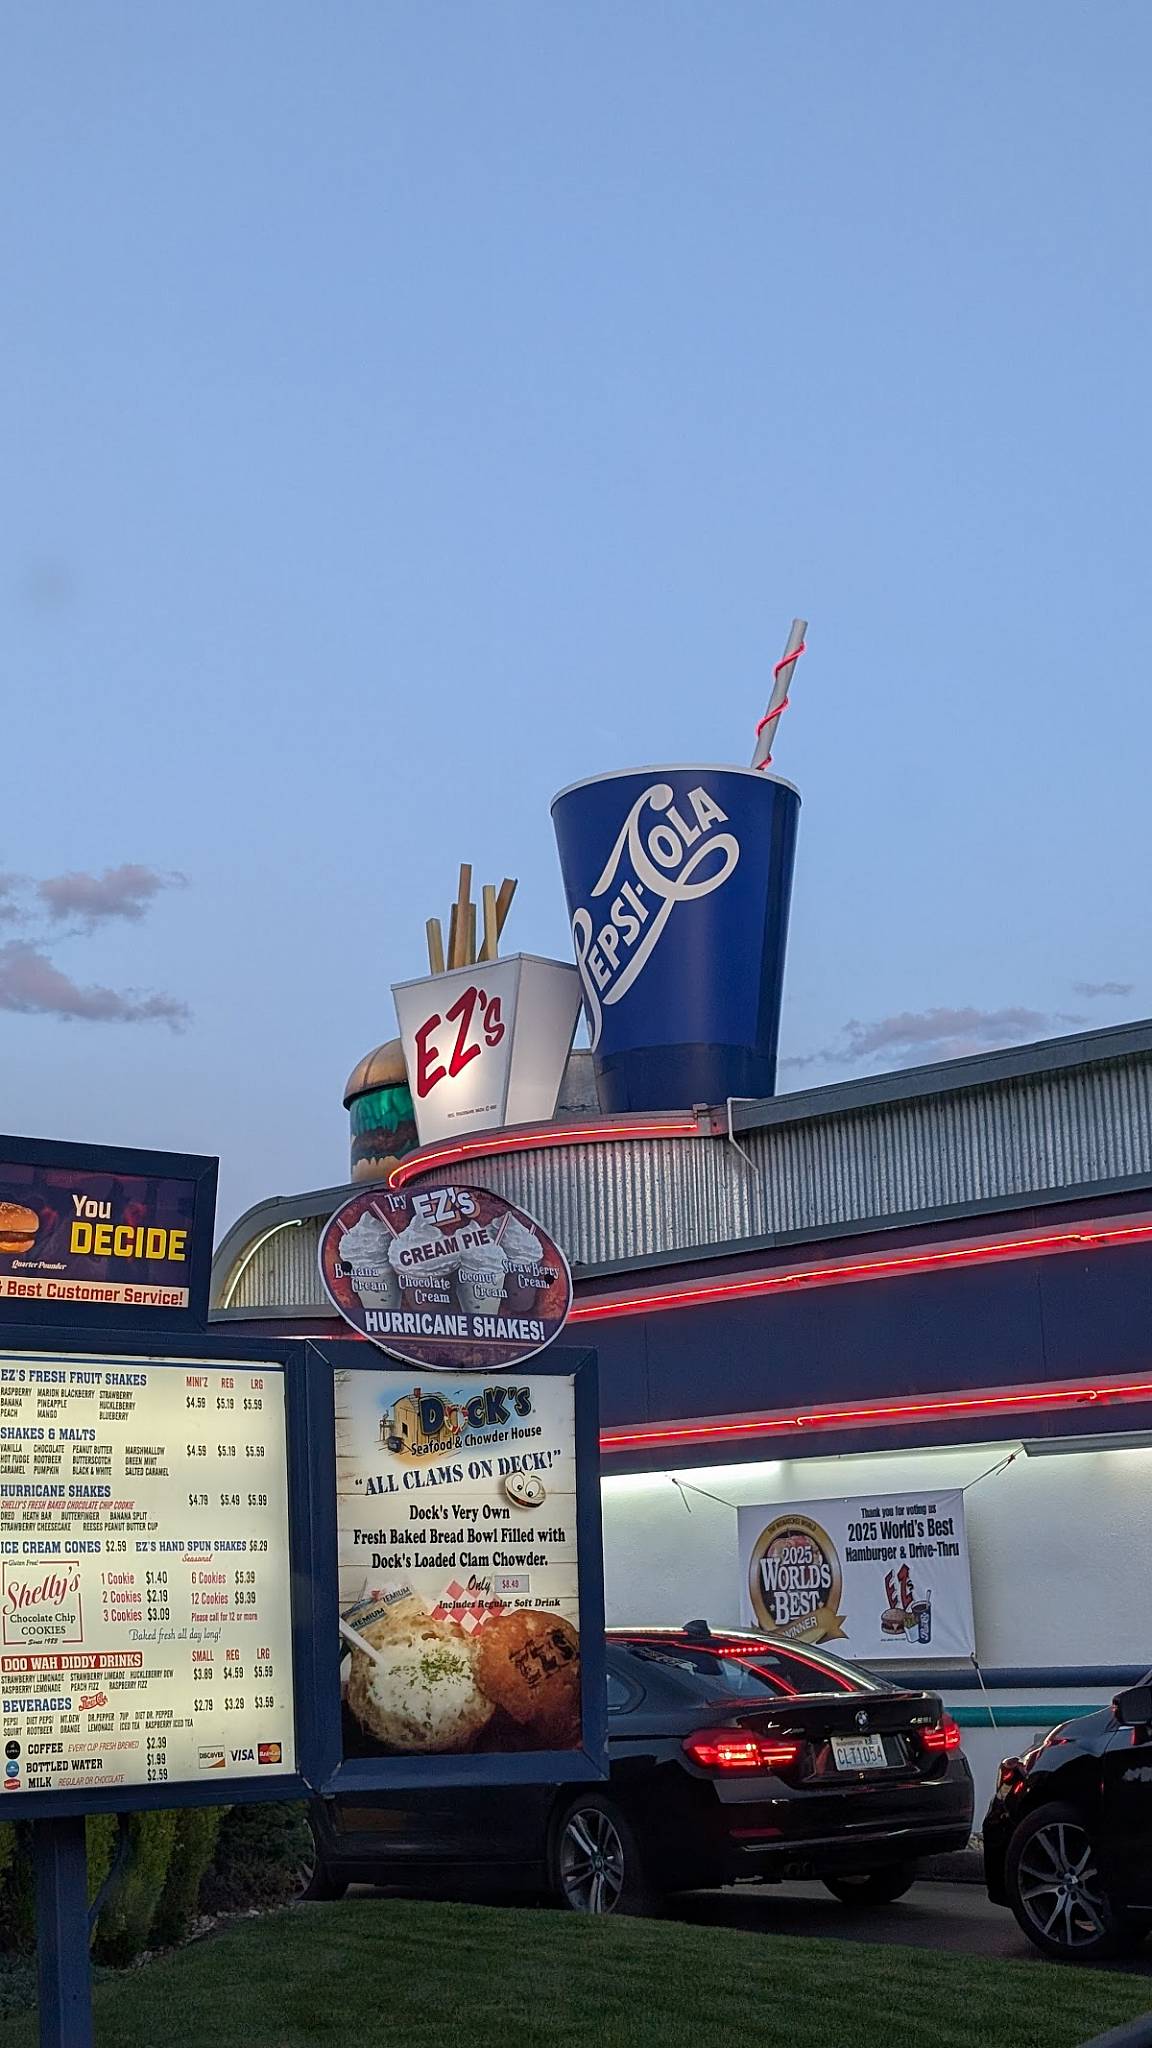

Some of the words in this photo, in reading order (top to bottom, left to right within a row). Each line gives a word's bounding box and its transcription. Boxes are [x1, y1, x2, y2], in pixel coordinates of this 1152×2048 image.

[72, 1194, 111, 1219] You
[384, 1193, 407, 1212] Try
[70, 1221, 187, 1260] DECIDE
[399, 1237, 460, 1266] CREAM
[462, 1229, 491, 1250] PIE
[12, 1259, 38, 1269] Quarter
[38, 1261, 67, 1270] Pounder
[334, 1263, 379, 1279] Bnana
[398, 1274, 450, 1290] Chocolate
[458, 1269, 497, 1285] Coconut
[7, 1281, 42, 1297] Best
[46, 1283, 120, 1301] Customer
[124, 1288, 183, 1305] Service!
[351, 1279, 388, 1293] Cream
[473, 1284, 508, 1299] Cream
[415, 1290, 450, 1305] Cream
[364, 1311, 468, 1336] HURRICANE
[473, 1317, 545, 1341] SHAKES!
[0, 1369, 26, 1381] EZ'S
[29, 1370, 66, 1383] FRESH
[69, 1371, 102, 1384] FRUIT
[105, 1372, 147, 1386] SHAKES
[221, 1377, 234, 1389] REG
[251, 1379, 263, 1390] LRG
[37, 1399, 68, 1408] PINEAPPLE
[99, 1401, 136, 1410] HUCKLEBERRY
[37, 1409, 58, 1418] MANGO
[0, 1427, 44, 1440] SHAKES
[60, 1428, 96, 1441] MALTS
[411, 1439, 452, 1456] Seafood
[454, 1436, 463, 1449] &
[464, 1429, 509, 1447] Chowder
[511, 1425, 542, 1440] House
[403, 1464, 464, 1490] CLAMS
[468, 1458, 495, 1480] ON
[0, 1484, 65, 1497] HURRICANE
[68, 1485, 111, 1498] SHAKES
[409, 1504, 449, 1521] Dock's
[451, 1504, 478, 1522] Very
[482, 1504, 510, 1520] Own
[860, 1507, 882, 1519] Thank
[882, 1507, 894, 1518] you
[895, 1506, 905, 1516] for
[906, 1504, 927, 1516] voting
[928, 1504, 937, 1514] us
[353, 1528, 386, 1545] Fresh
[389, 1528, 427, 1544] Baked
[429, 1528, 464, 1544] Bread
[467, 1528, 500, 1544] Bowl
[500, 1528, 535, 1543] Filled
[537, 1527, 566, 1542] with
[847, 1522, 878, 1542] 2025
[880, 1520, 925, 1539] World's
[926, 1517, 955, 1537] Best
[0, 1541, 19, 1553] ICE
[22, 1541, 61, 1553] CREAM
[64, 1540, 101, 1553] CONES
[105, 1540, 127, 1553] $2.59
[136, 1541, 157, 1552] EZ'S
[159, 1541, 185, 1552] HAND
[187, 1541, 211, 1552] SPUN
[213, 1541, 247, 1552] SHAKES
[845, 1545, 898, 1562] Hamburger
[899, 1547, 907, 1559] &
[908, 1540, 960, 1559] Drive-Thru
[182, 1553, 213, 1563] Seasonal
[371, 1553, 411, 1569] Dock's
[414, 1552, 456, 1568] Loaded
[459, 1552, 490, 1567] Clam
[492, 1551, 548, 1567] Chowder.
[782, 1546, 813, 1566] 2025
[107, 1572, 134, 1585] Cookie
[146, 1570, 168, 1585] $1.40
[191, 1571, 197, 1584] 6
[198, 1571, 227, 1585] Cookies
[235, 1570, 256, 1584] $5.39
[467, 1574, 491, 1595] Only
[3, 1566, 81, 1615] Shelly's
[102, 1591, 108, 1603] 2
[110, 1590, 142, 1604] Cookies
[146, 1589, 168, 1604] $2.19
[191, 1592, 200, 1605] 12
[201, 1592, 229, 1605] Cookies
[234, 1590, 256, 1605] $9.39
[439, 1599, 476, 1610] Includes
[477, 1599, 512, 1610] Regular
[514, 1598, 533, 1608] Soft
[534, 1598, 561, 1608] Drink
[774, 1590, 820, 1626] BEST
[10, 1613, 54, 1624] Chocolate
[54, 1613, 76, 1624] Chip
[103, 1609, 108, 1622] 3
[111, 1609, 143, 1622] Cookies
[147, 1607, 170, 1622] $3.09
[191, 1612, 209, 1623] Please
[220, 1611, 228, 1622] for
[229, 1611, 236, 1622] 12
[21, 1626, 66, 1636] COOKIES
[129, 1628, 157, 1642] Baked
[157, 1627, 176, 1644] fresh
[177, 1628, 187, 1640] all
[189, 1628, 202, 1643] day
[204, 1627, 221, 1643] long!
[4, 1657, 28, 1671] DOO
[30, 1656, 58, 1670] WAH
[61, 1654, 97, 1670] DIDDY
[100, 1653, 142, 1669] DRINKS
[192, 1650, 214, 1662] SMALL
[226, 1649, 240, 1660] REG
[256, 1648, 270, 1660] LRG
[224, 1667, 244, 1679] $4.59
[2, 1697, 72, 1713] BEVERAGES
[194, 1699, 213, 1712] $2.79
[225, 1698, 245, 1710] $3.29
[28, 1742, 63, 1755] COFFEE
[200, 1751, 224, 1759] DISCOVER
[230, 1749, 255, 1761] VISA
[837, 1744, 883, 1765] CLT1054
[26, 1760, 69, 1773] BOTTLED
[70, 1759, 103, 1772] WATER
[28, 1776, 52, 1789] MILK
